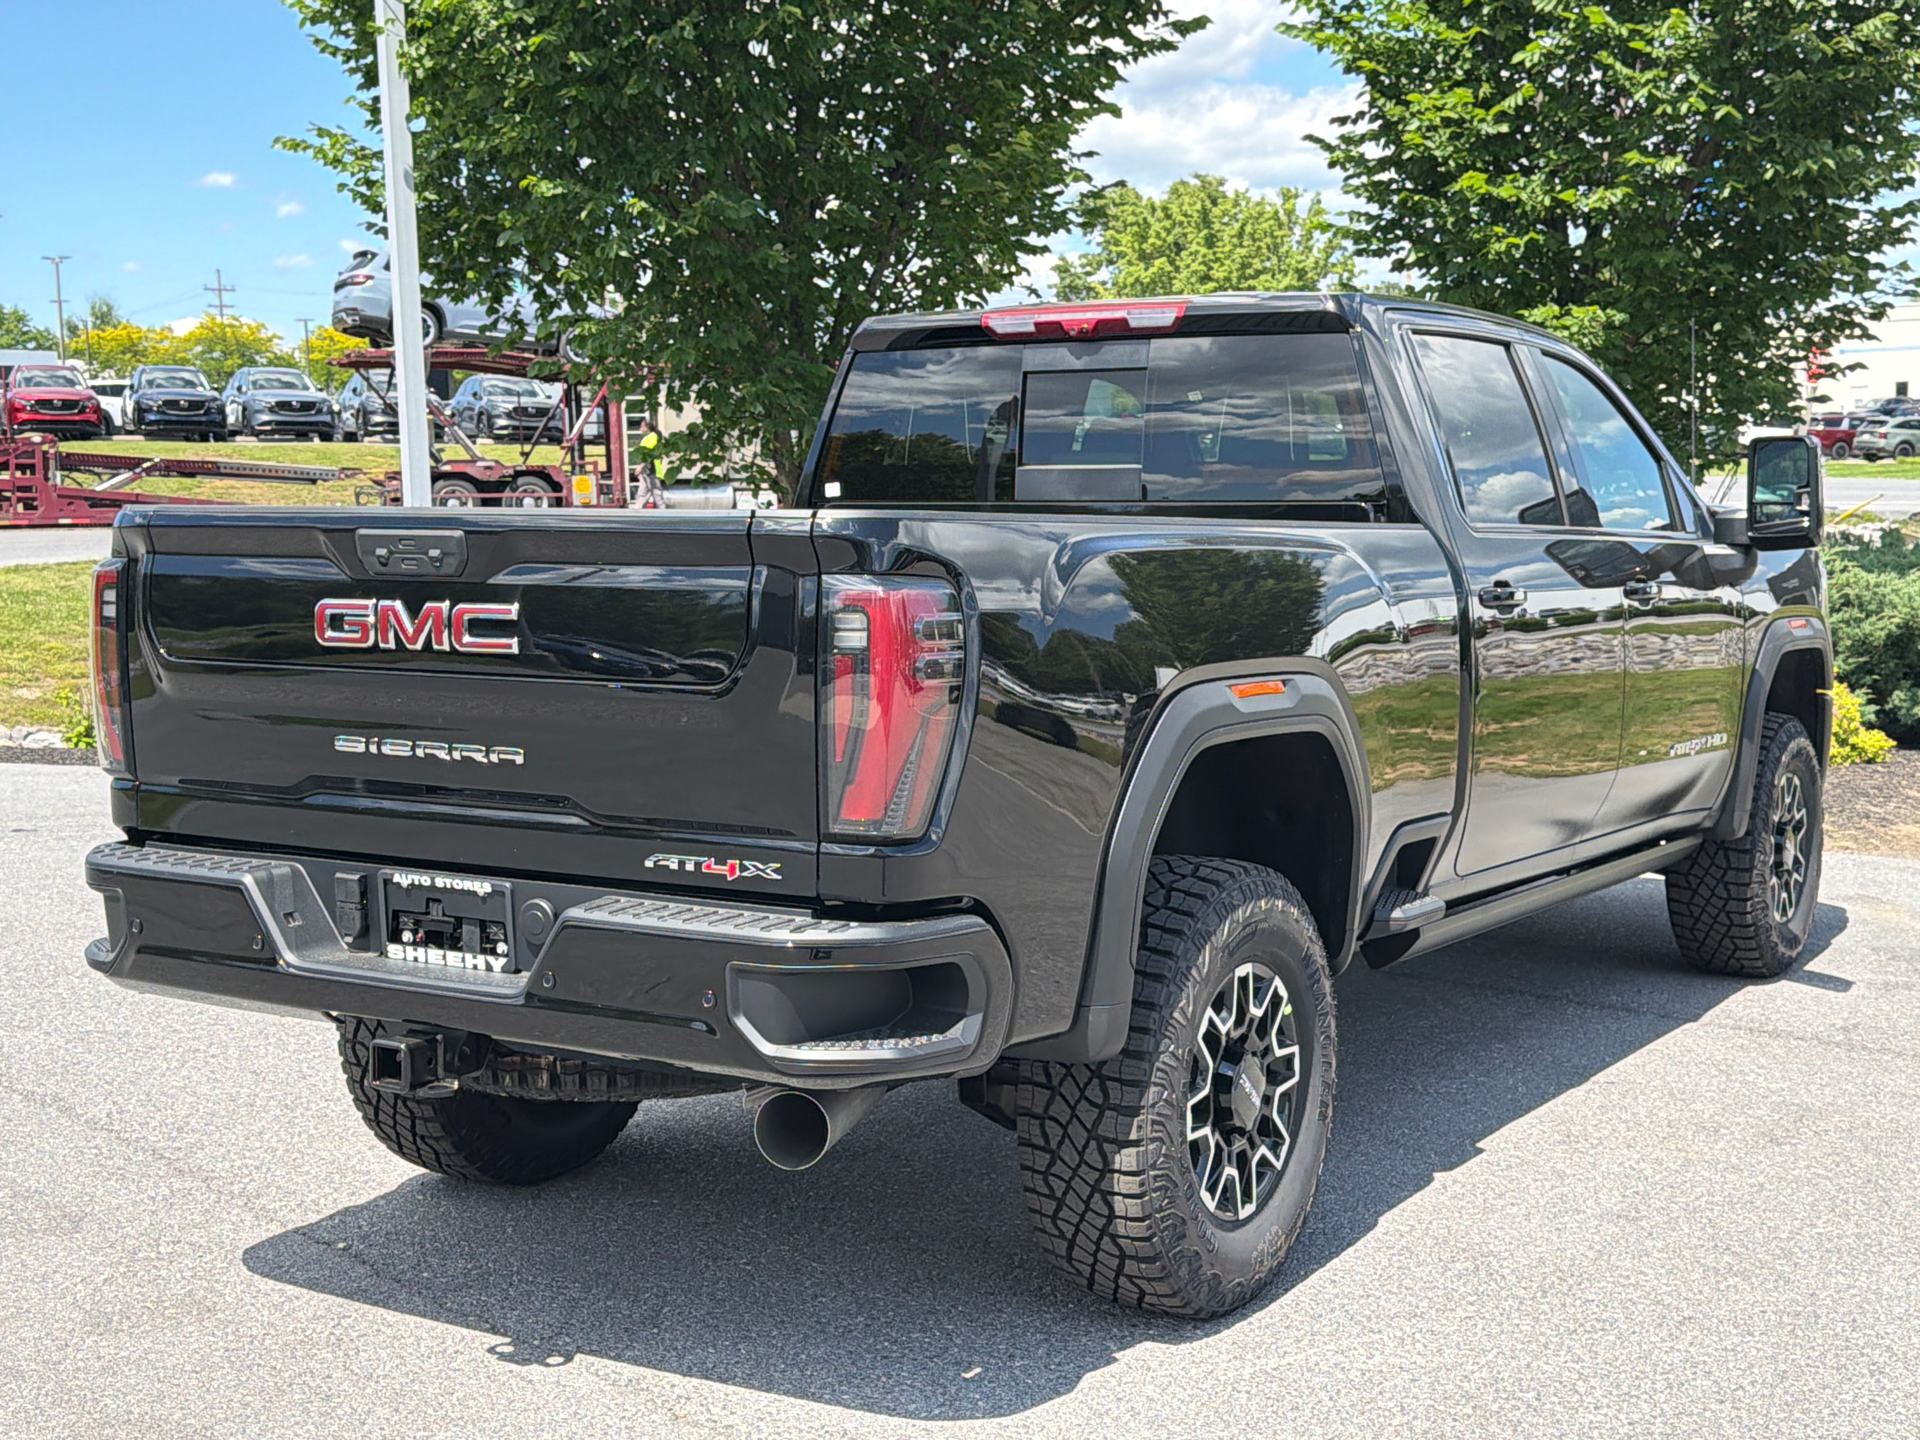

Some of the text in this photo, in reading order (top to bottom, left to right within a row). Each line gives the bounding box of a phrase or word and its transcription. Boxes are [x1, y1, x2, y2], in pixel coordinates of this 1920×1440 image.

[314, 598, 520, 655] GMC
[334, 735, 525, 765] SIERRA
[644, 853, 783, 881] AT4X
[392, 872, 493, 893] AUTO STORES
[386, 943, 509, 972] SHEEHY
